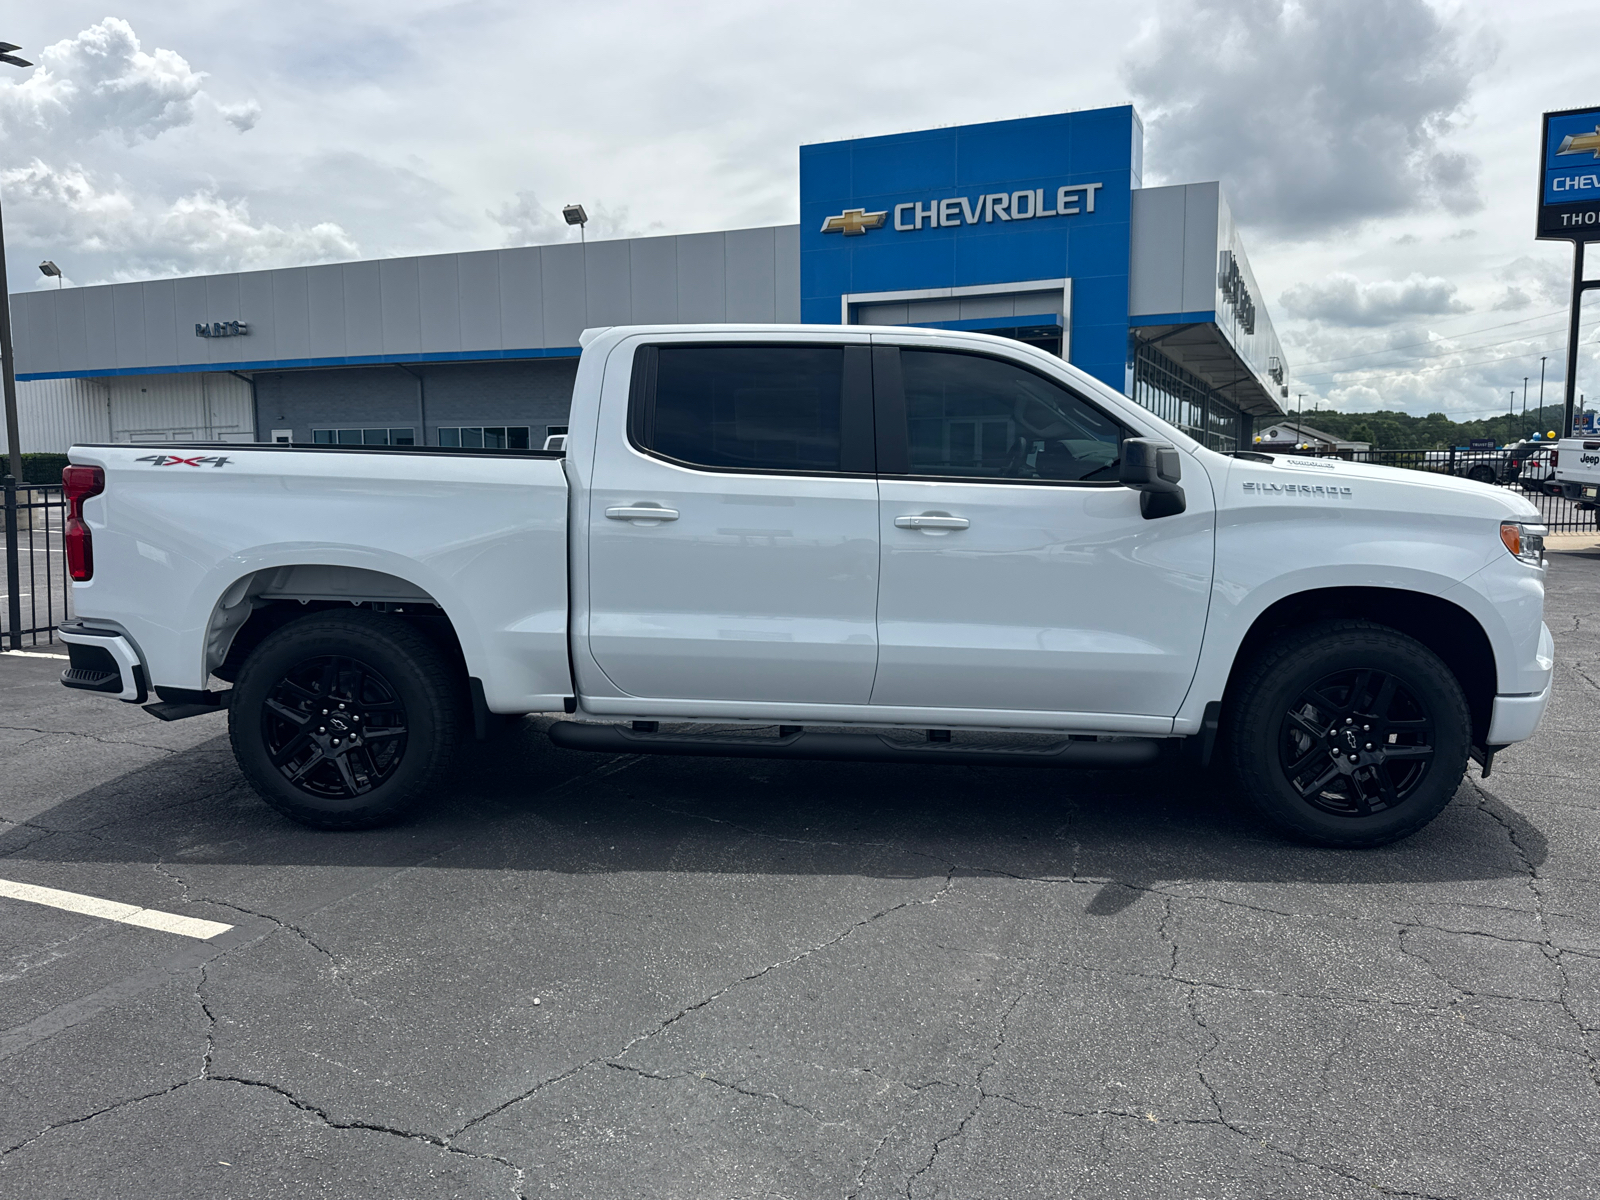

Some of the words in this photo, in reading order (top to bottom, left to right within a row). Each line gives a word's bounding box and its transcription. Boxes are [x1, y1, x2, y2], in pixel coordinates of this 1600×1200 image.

[894, 182, 1102, 231] CHEVROLET
[1560, 211, 1600, 226] THO
[195, 320, 245, 337] PARTS
[1580, 453, 1600, 466] Jeep
[1243, 482, 1352, 495] SILVERADO
